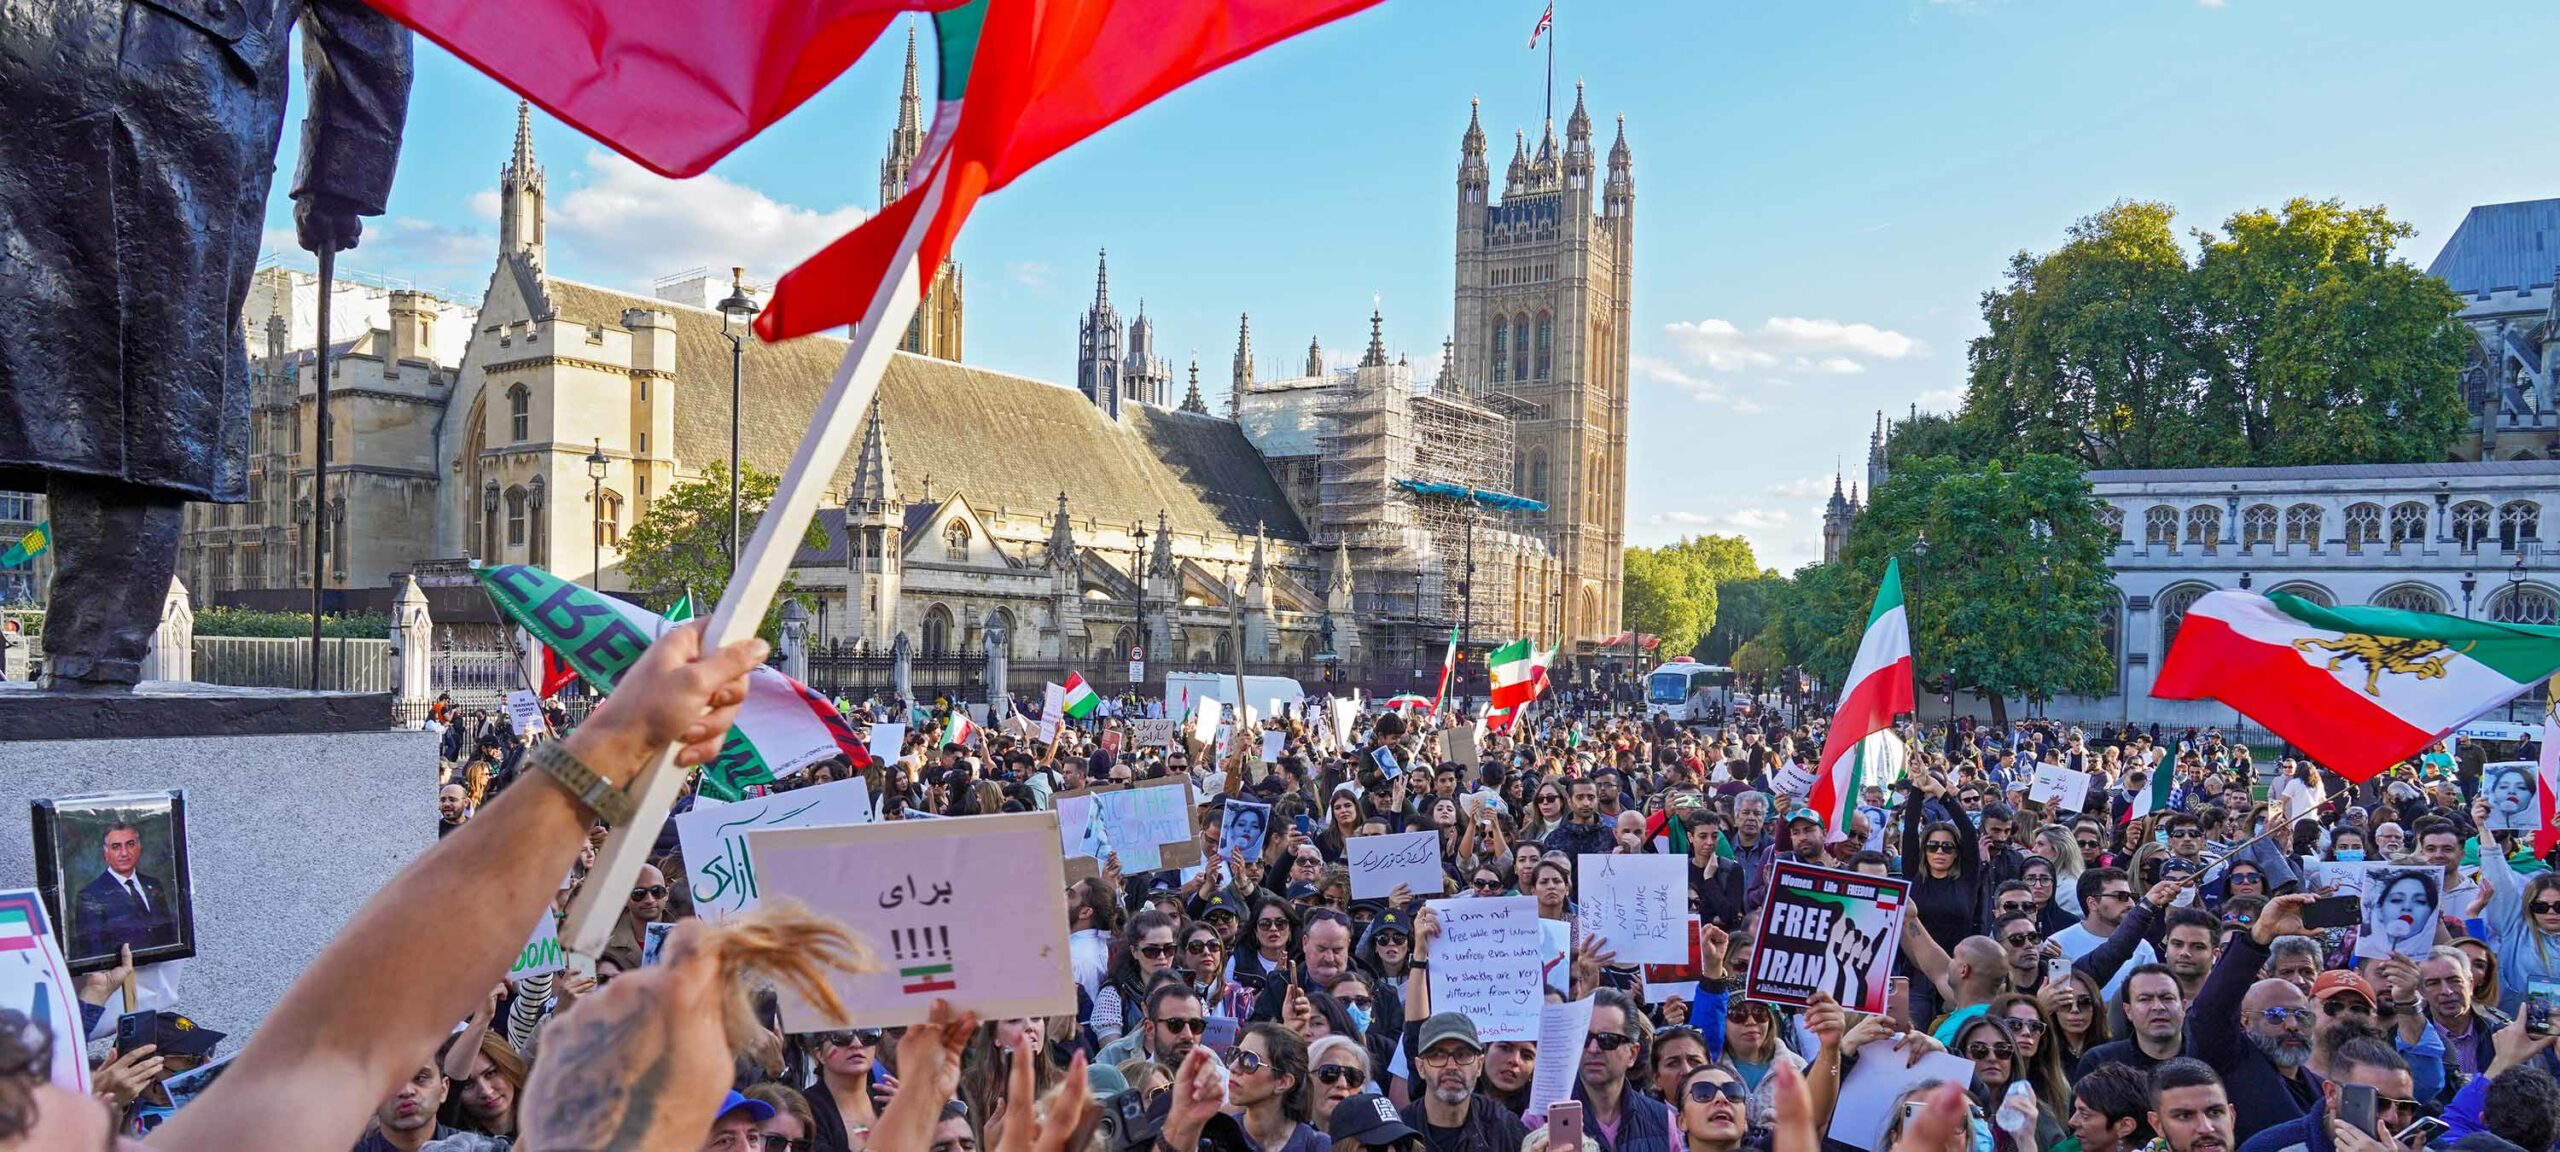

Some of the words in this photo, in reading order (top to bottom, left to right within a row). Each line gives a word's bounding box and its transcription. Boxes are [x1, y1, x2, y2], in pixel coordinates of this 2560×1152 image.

[879, 873, 952, 909] برای
[1780, 873, 1813, 890] Women
[1823, 880, 1839, 893] Life
[1846, 883, 1876, 898] FREEDOM
[1441, 908, 1454, 923] I
[1460, 912, 1484, 922] am
[1490, 906, 1511, 919] not
[1579, 898, 1590, 921] ARE
[1591, 896, 1603, 931] IRAN
[1612, 887, 1628, 930] NOT
[1633, 884, 1650, 941] ISLAMIC
[1652, 883, 1677, 940] Republic
[1769, 901, 1832, 942] FREE
[1448, 926, 1468, 943] free
[1470, 928, 1489, 938] while
[1487, 949, 1510, 958] even
[1513, 947, 1539, 957] when
[1496, 971, 1510, 980] are
[1518, 969, 1539, 987] very
[1757, 948, 1825, 988] IRAN
[1446, 987, 1482, 999] different
[1489, 984, 1511, 997] from
[1512, 988, 1532, 1005] my
